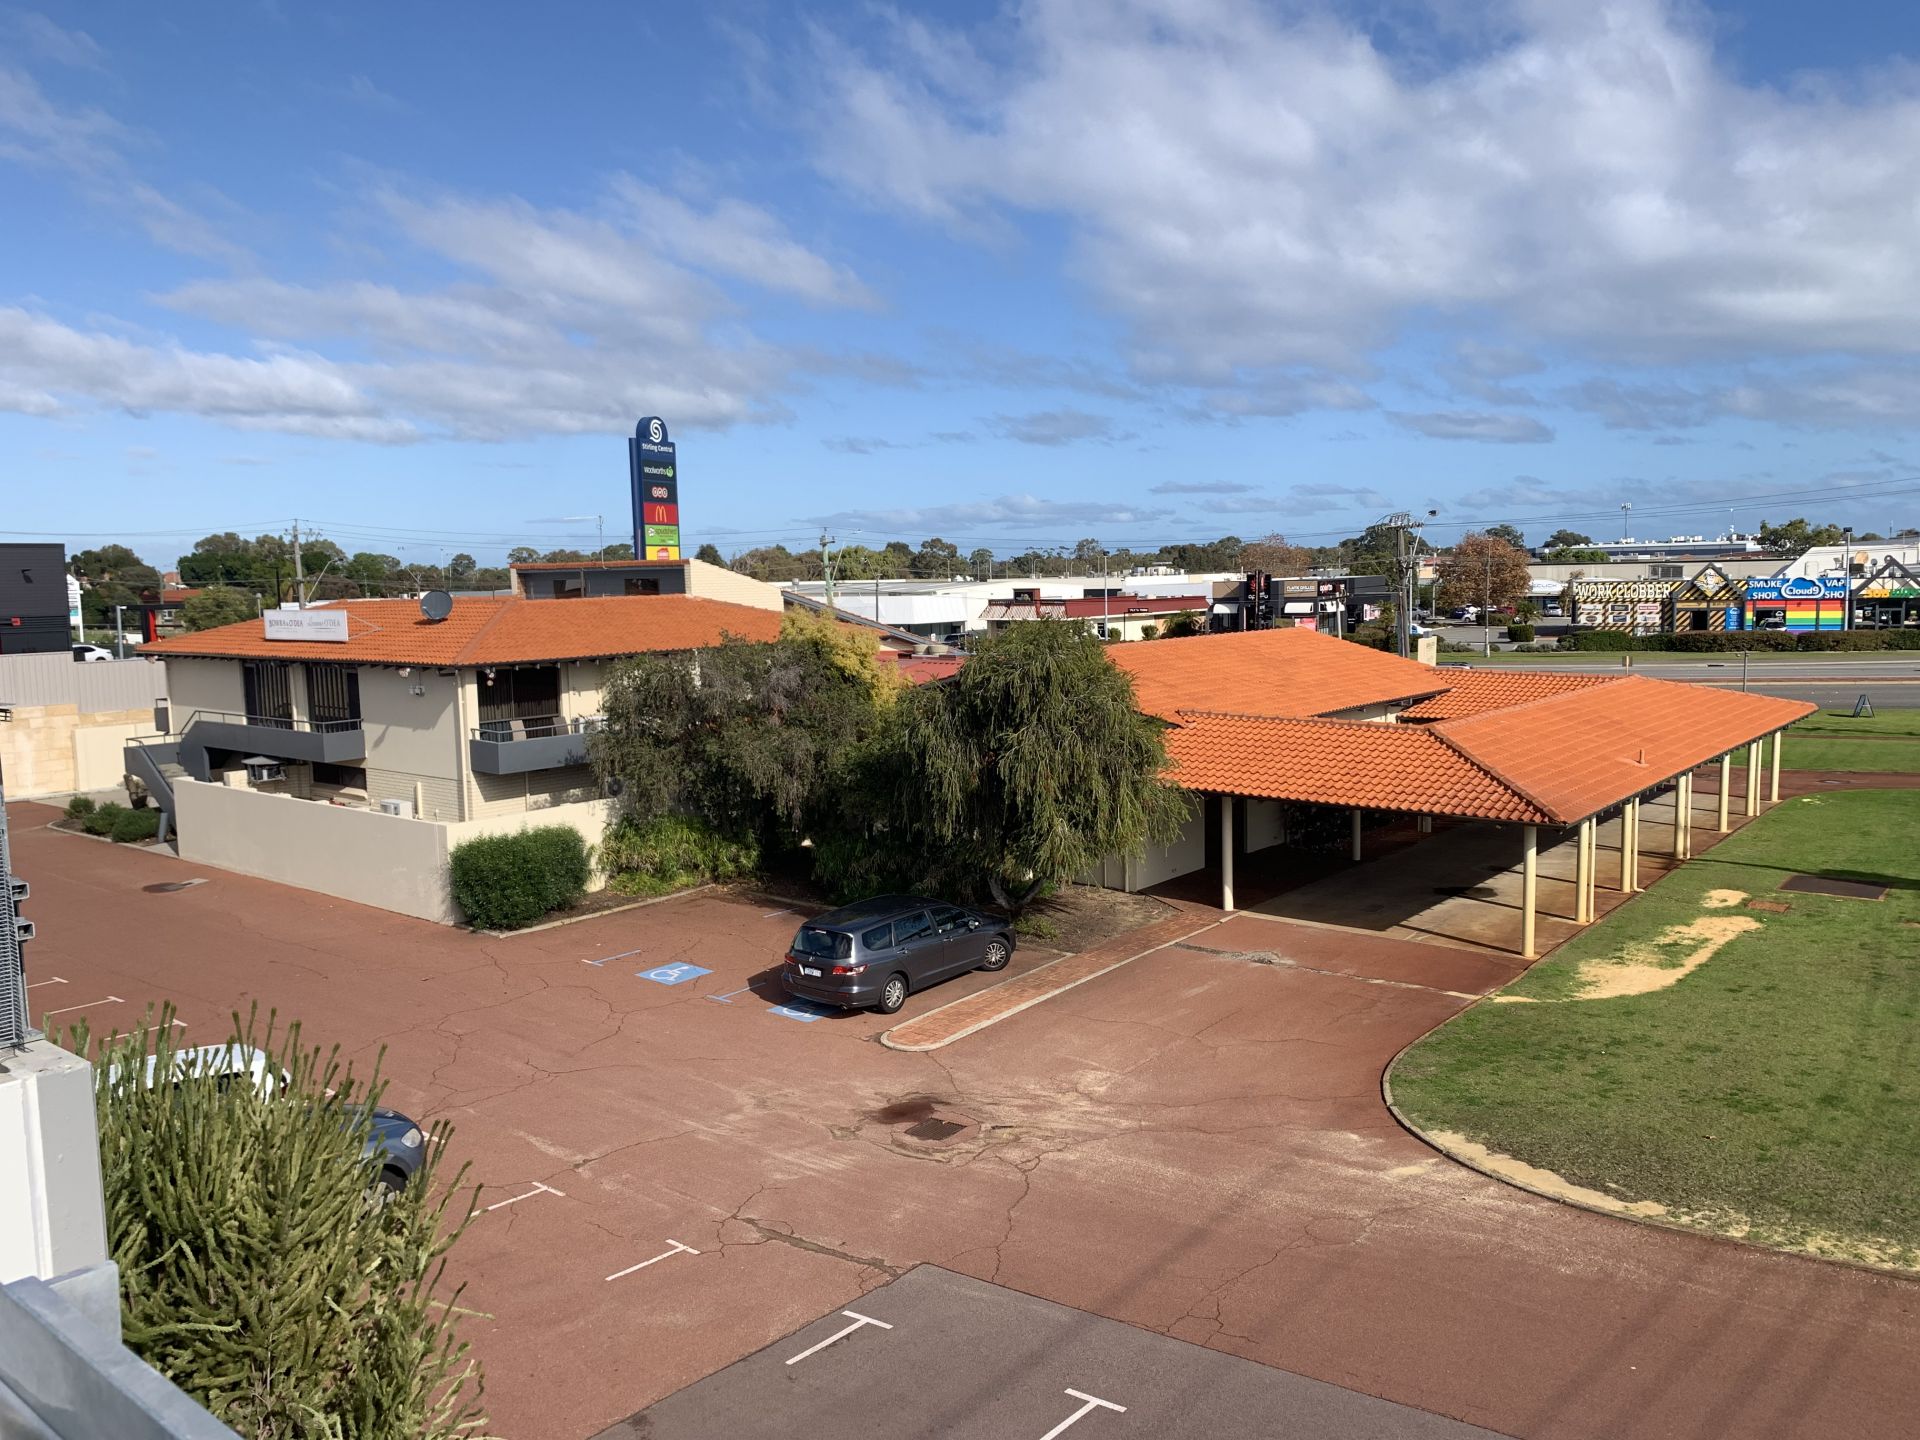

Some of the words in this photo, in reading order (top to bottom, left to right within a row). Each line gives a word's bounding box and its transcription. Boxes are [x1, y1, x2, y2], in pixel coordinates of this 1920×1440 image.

[642, 443, 658, 452] Stirling
[658, 445, 673, 453] Central
[1749, 580, 1783, 588] SMOKE
[1577, 584, 1613, 598] WORK
[1616, 584, 1672, 598] CLOBBER
[1786, 586, 1820, 596] Cloud9
